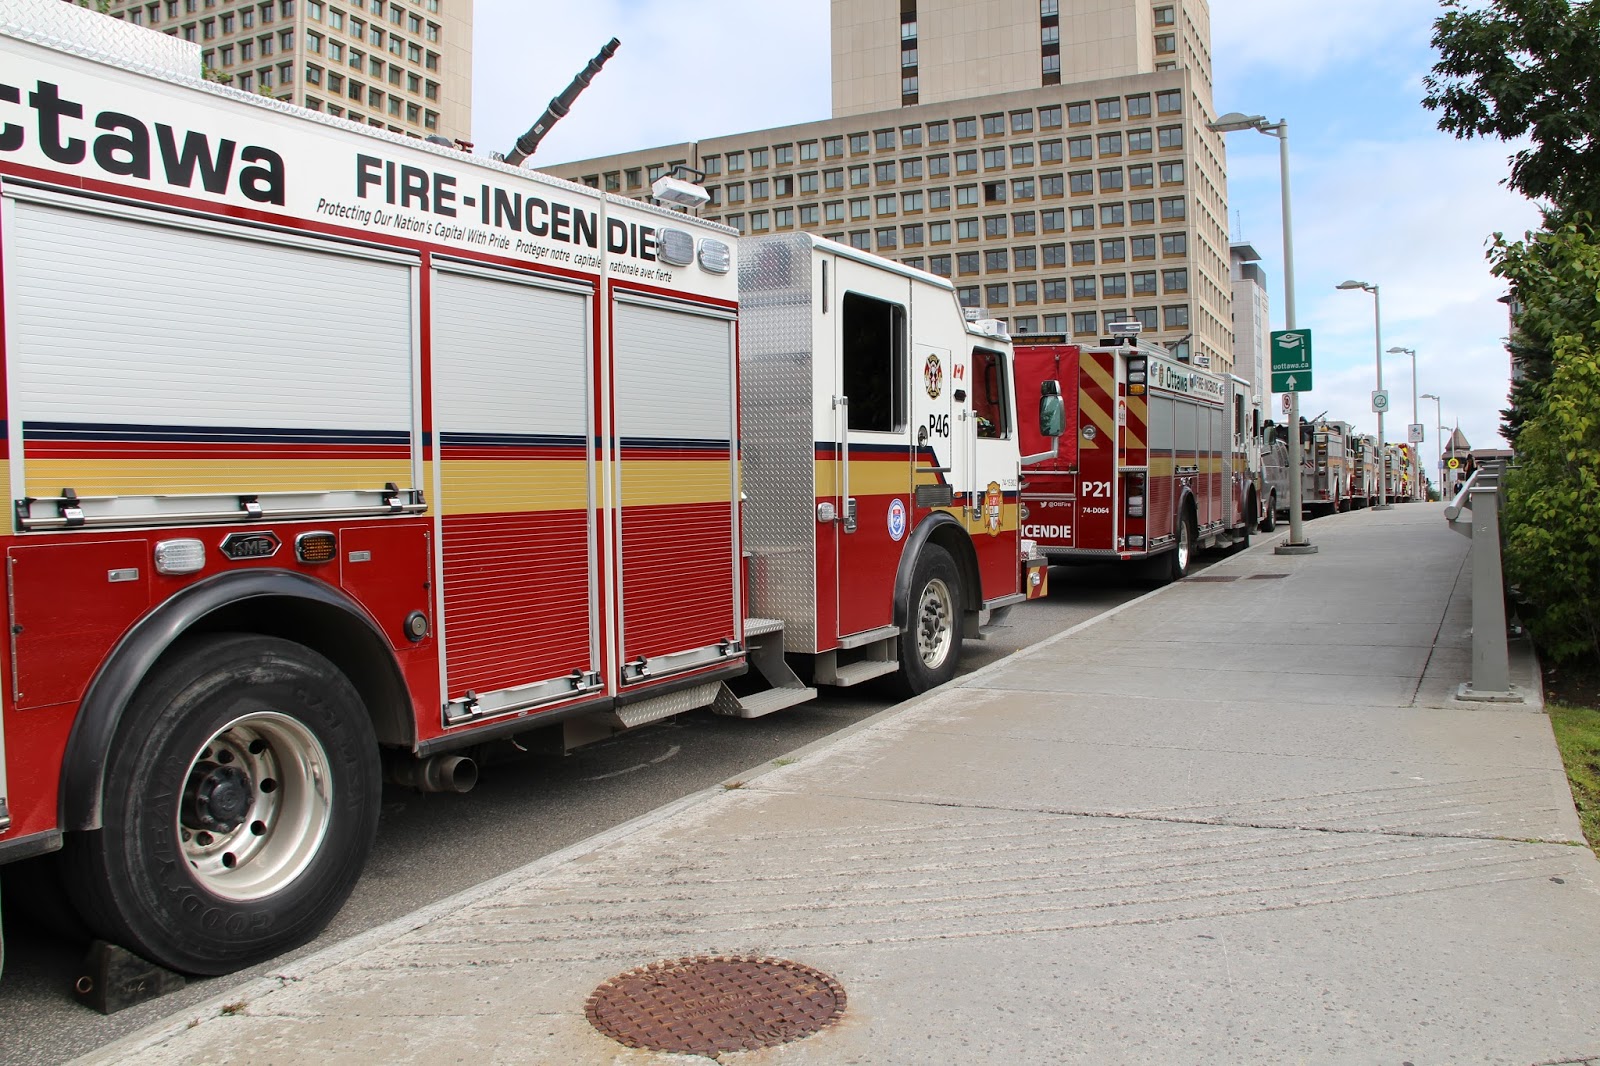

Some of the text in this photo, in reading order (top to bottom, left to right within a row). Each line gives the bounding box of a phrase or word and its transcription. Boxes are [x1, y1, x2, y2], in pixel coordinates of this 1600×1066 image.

[357, 153, 656, 262] FIRE-INCENDIE
[316, 197, 672, 283] Protecting Our Nation's Capital With Pride Protéger notre capitale nationale avec fierté
[1273, 362, 1309, 370] uottawa.ca
[929, 414, 949, 438] P46
[1082, 481, 1111, 497] P21
[232, 540, 269, 551] KME
